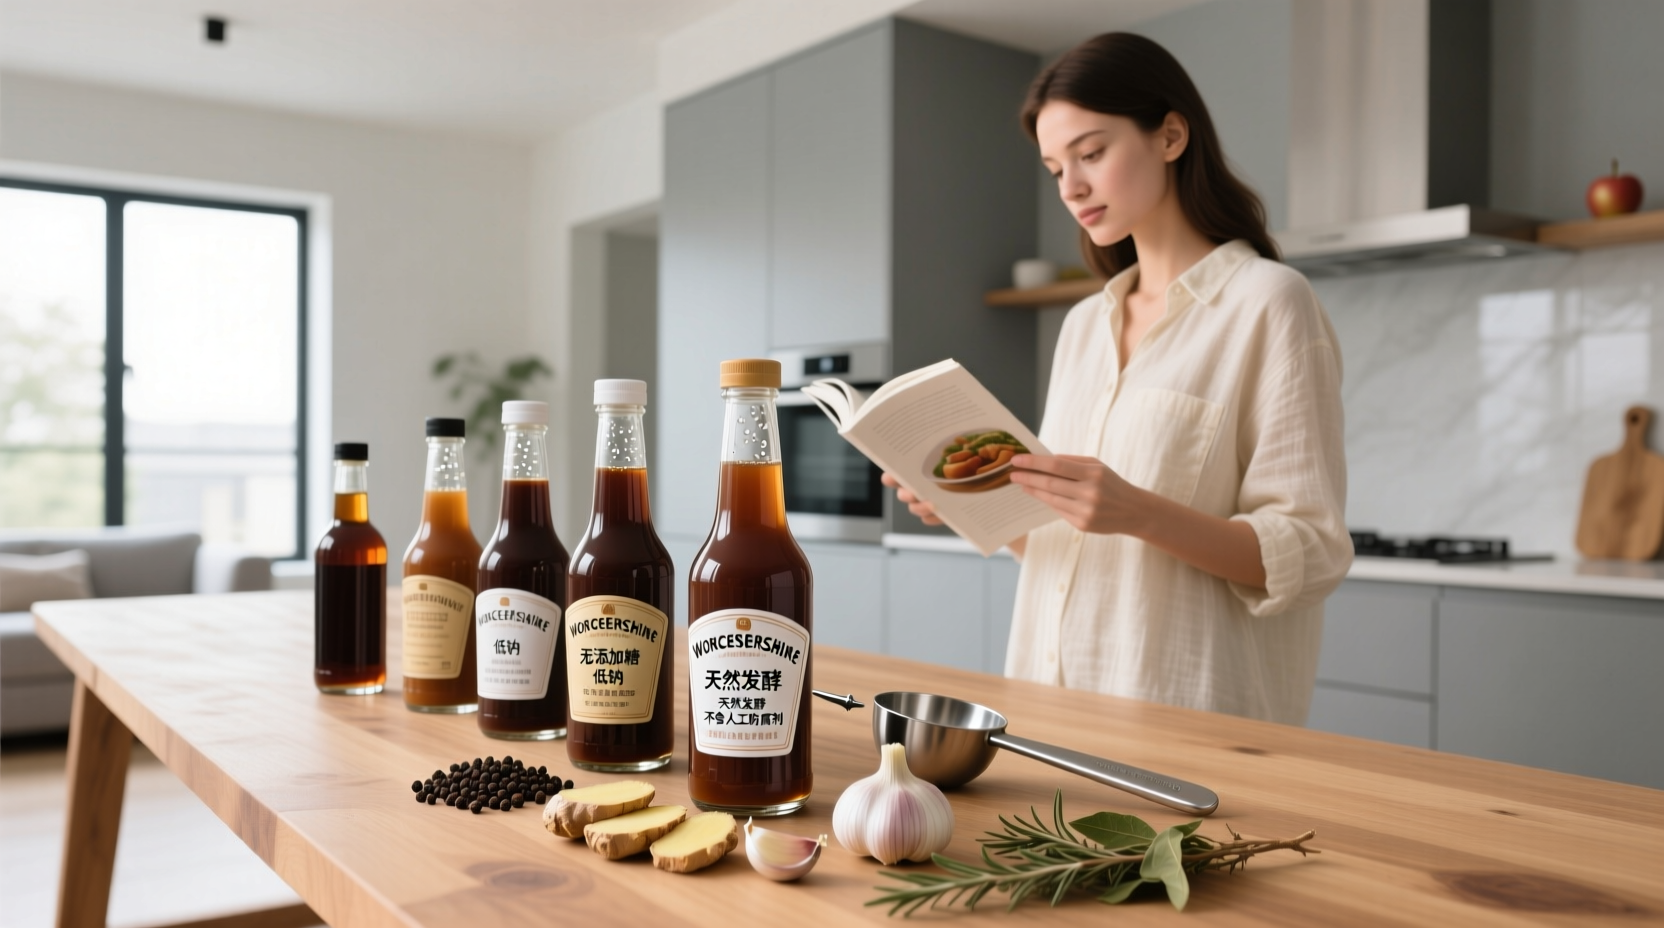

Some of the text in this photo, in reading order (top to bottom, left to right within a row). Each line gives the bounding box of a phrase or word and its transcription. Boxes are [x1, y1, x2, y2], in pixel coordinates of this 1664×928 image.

[580, 647, 640, 666] 无添加糖
[692, 633, 801, 665] WORCESERSHINE
[592, 668, 624, 685] 低钠
[705, 669, 783, 691] 天然发酵
